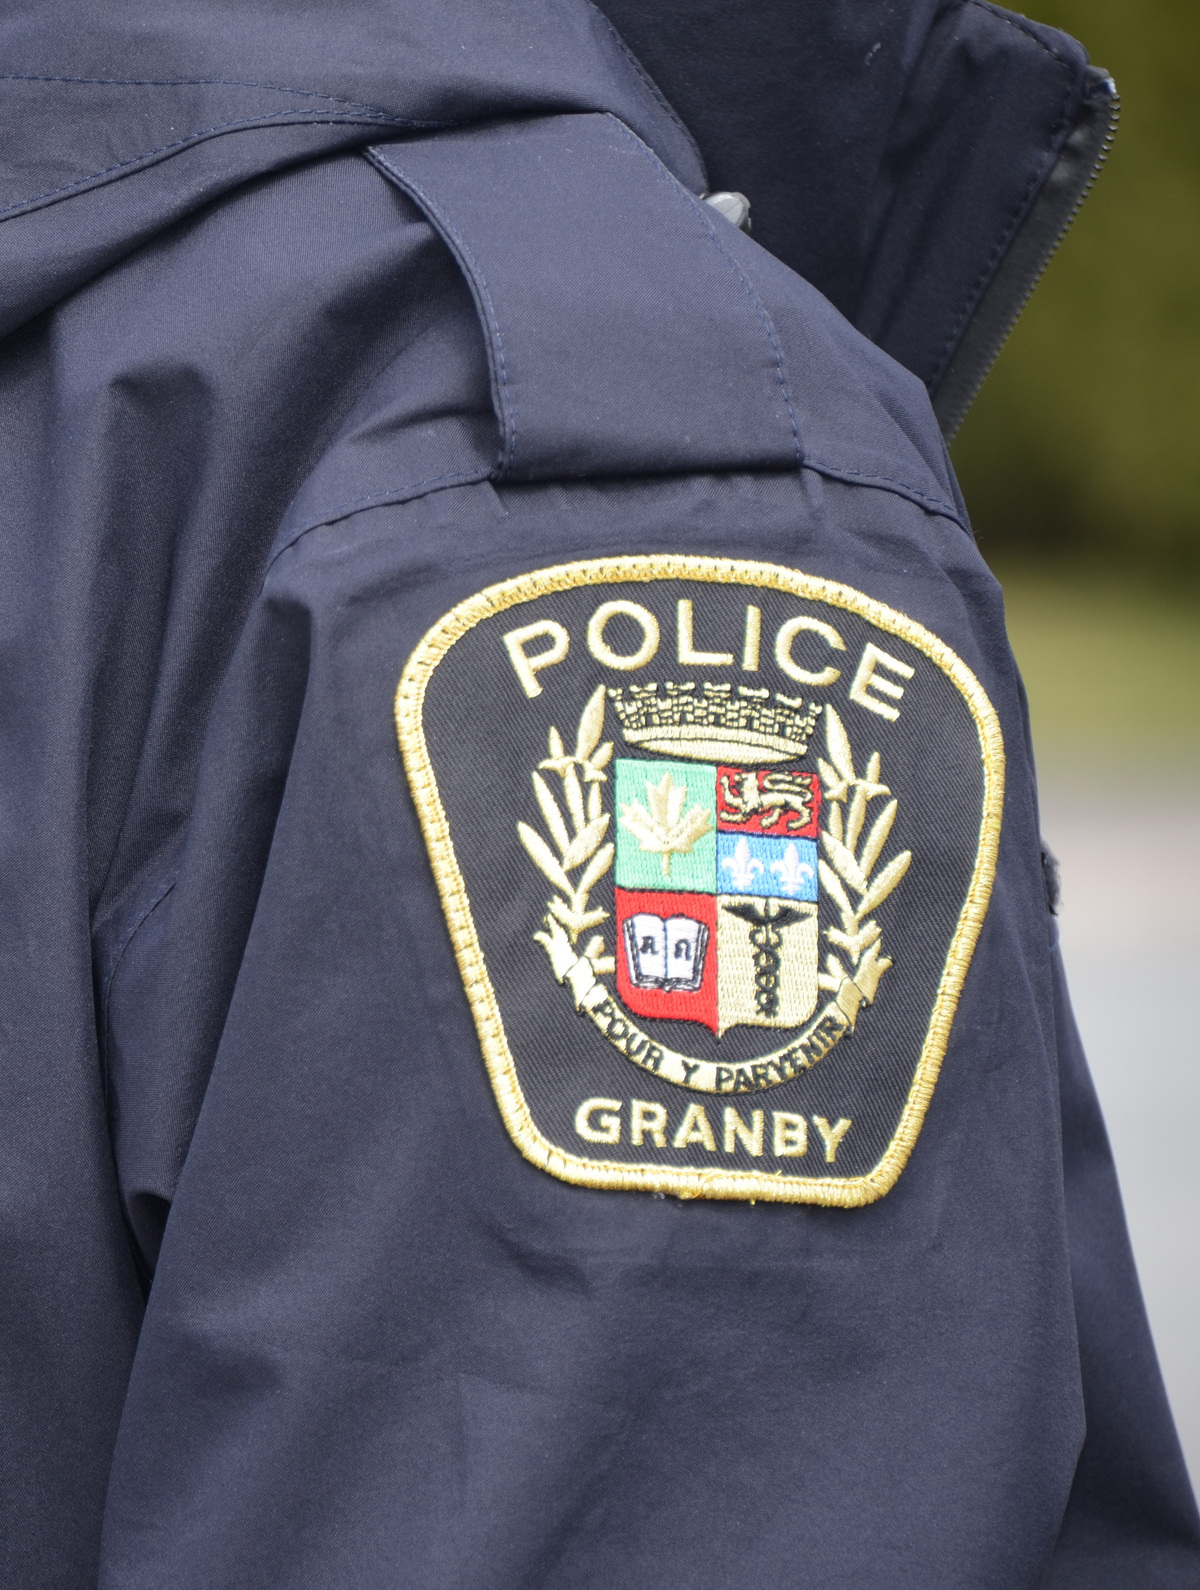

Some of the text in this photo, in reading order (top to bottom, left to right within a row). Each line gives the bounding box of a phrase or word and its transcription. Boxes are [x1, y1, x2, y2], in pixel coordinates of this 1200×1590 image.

[503, 599, 915, 722] POLICE
[593, 1000, 845, 1092] POUR Y PARVENIR
[575, 1097, 852, 1163] GRANBY
